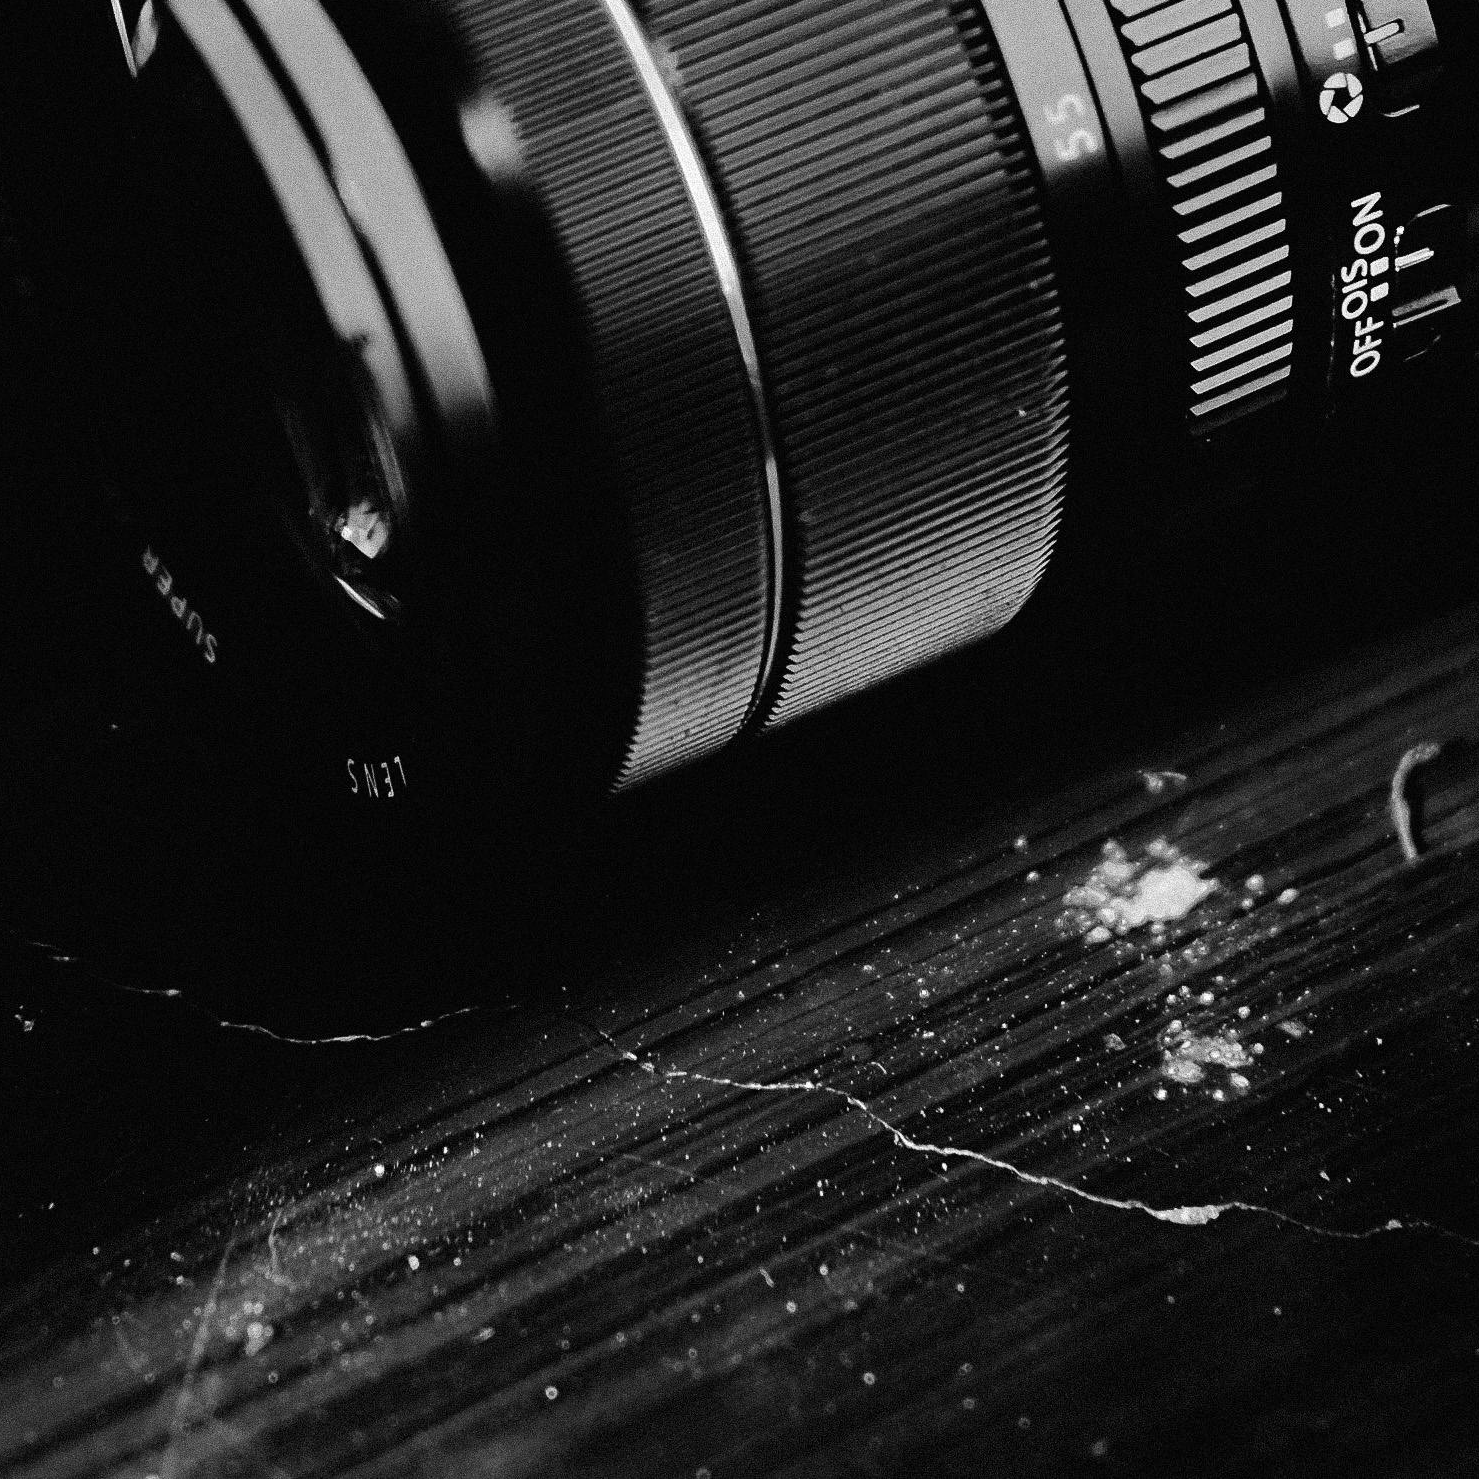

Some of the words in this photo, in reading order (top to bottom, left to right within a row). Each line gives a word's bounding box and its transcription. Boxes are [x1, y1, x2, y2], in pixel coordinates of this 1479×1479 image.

[1043, 93, 1099, 161] 55
[1351, 191, 1386, 255] ON
[1341, 258, 1368, 320] OIS
[1350, 316, 1384, 379] OFF
[345, 754, 408, 799] LENS
